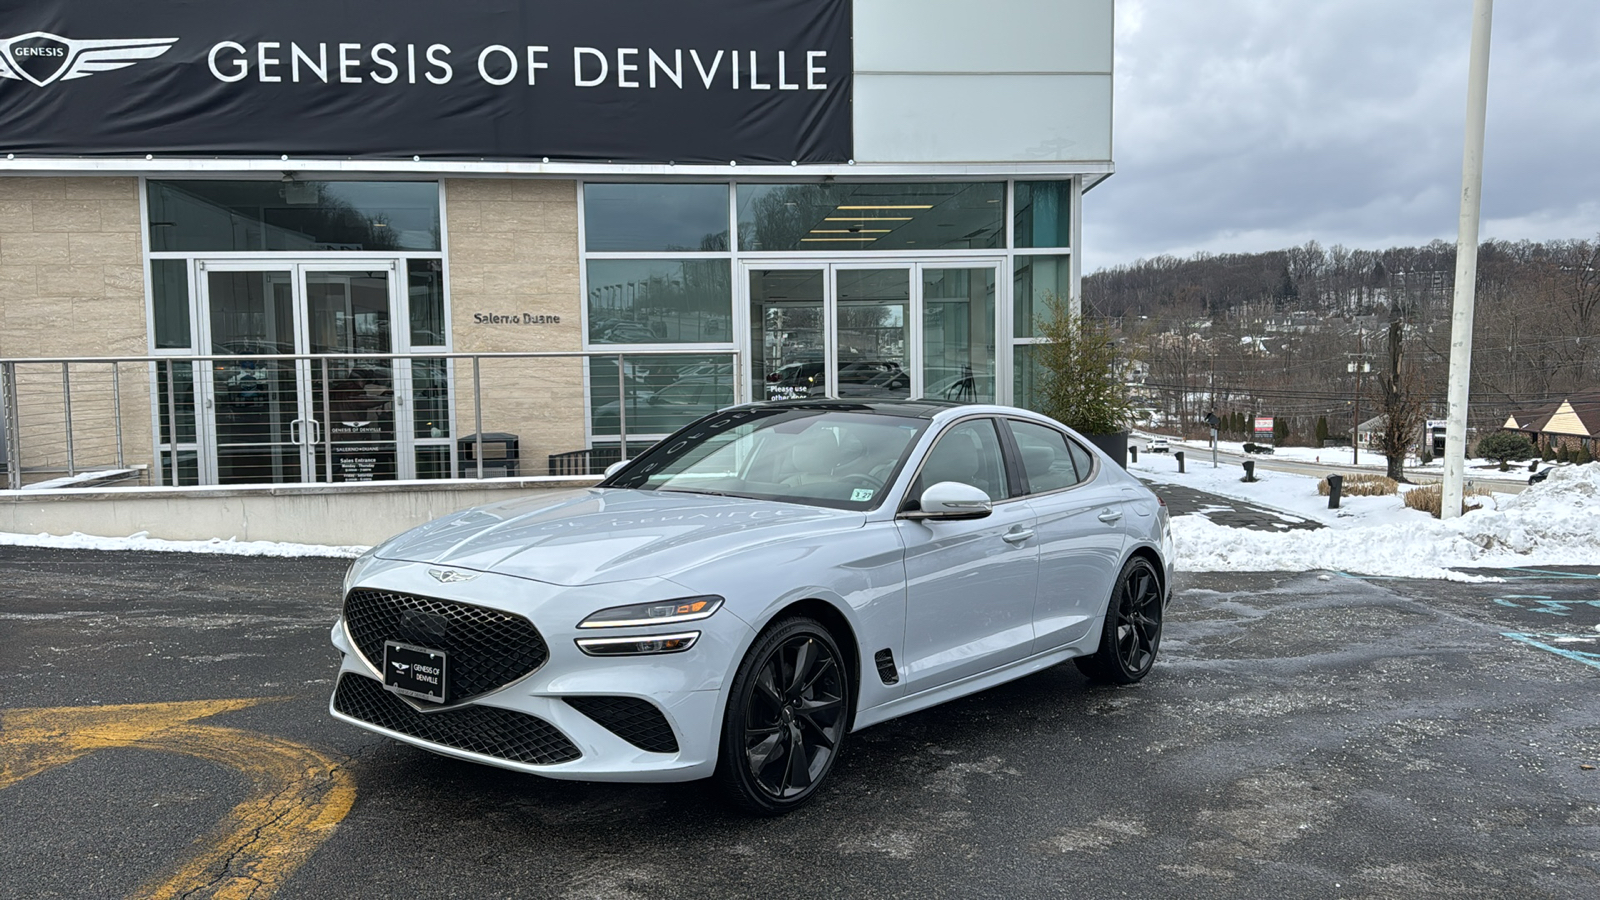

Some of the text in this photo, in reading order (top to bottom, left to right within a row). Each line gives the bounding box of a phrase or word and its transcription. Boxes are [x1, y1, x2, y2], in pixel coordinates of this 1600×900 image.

[15, 47, 64, 57] GENESIS
[207, 40, 828, 90] GENESIS OF DENVILLE
[522, 312, 561, 325] Duane
[770, 385, 793, 393] Please
[413, 664, 432, 674] GENESIS
[433, 667, 440, 676] OF
[416, 673, 438, 685] DENVILLE
